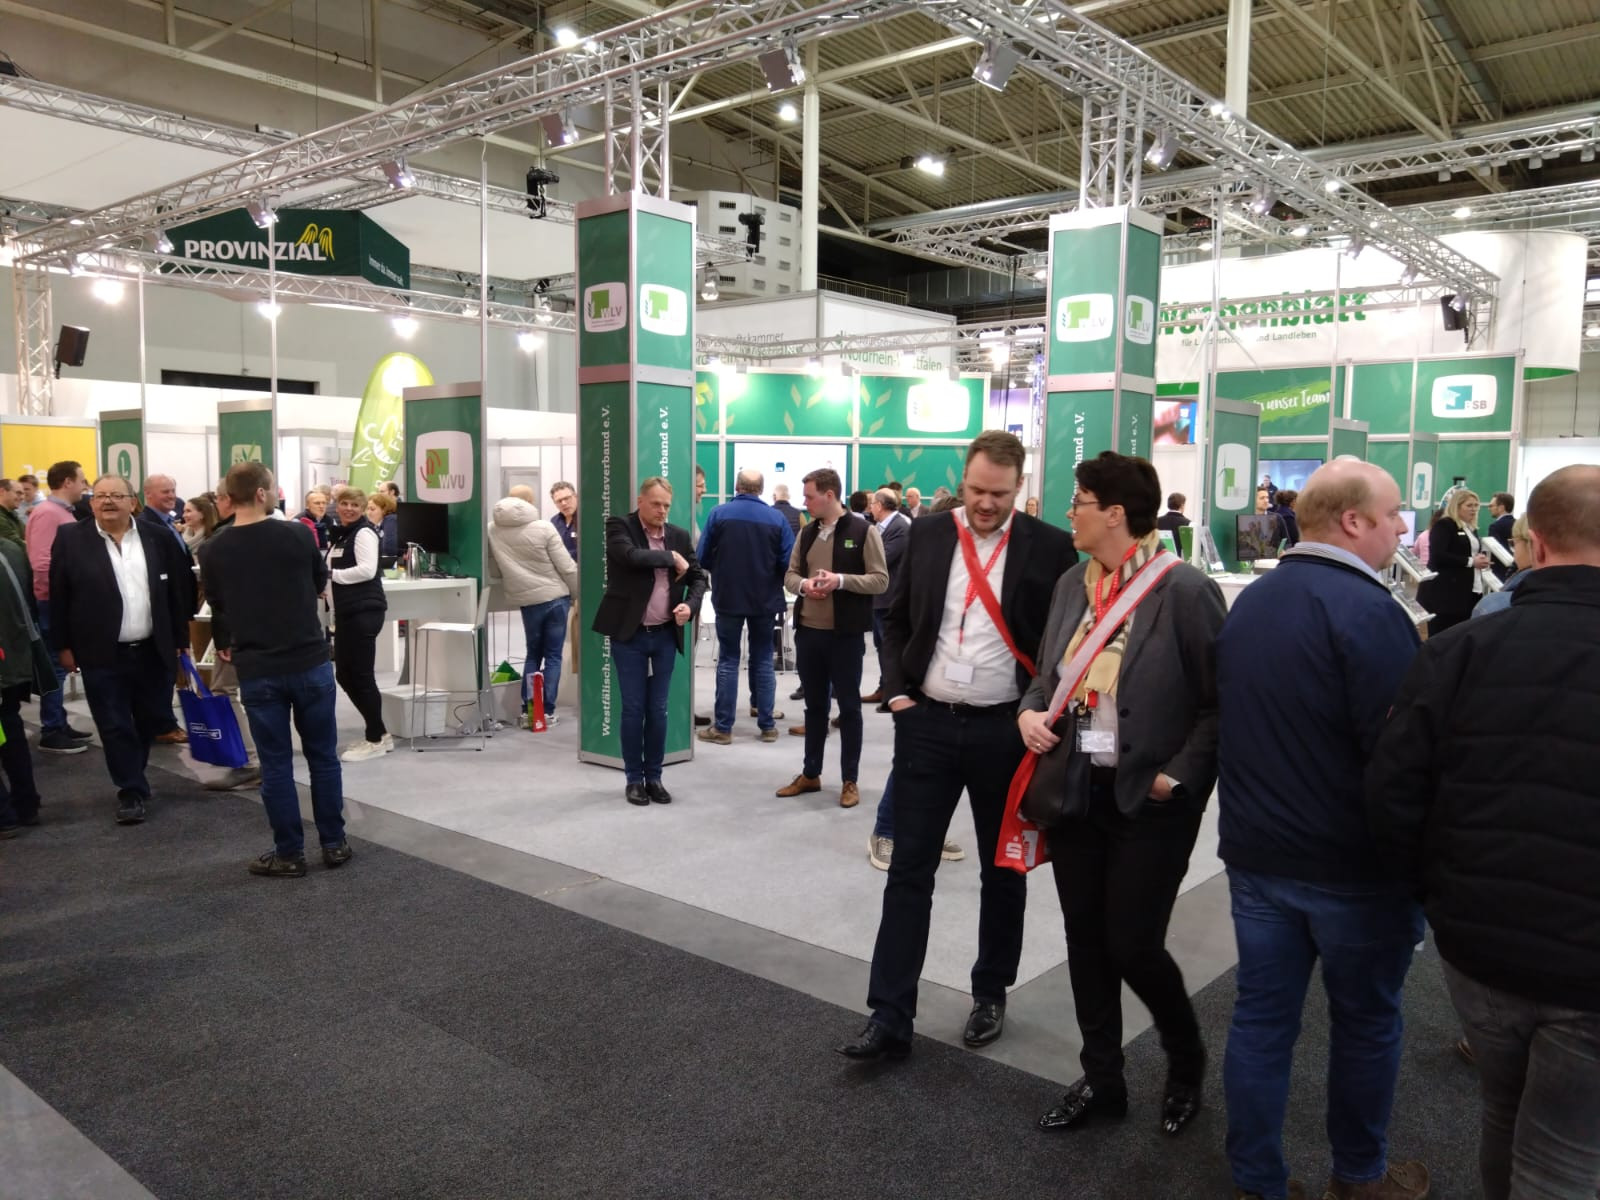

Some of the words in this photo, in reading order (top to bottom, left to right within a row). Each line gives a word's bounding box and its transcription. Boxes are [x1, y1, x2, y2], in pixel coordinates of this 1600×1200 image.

[184, 240, 327, 261] PROVINZIAL
[1272, 332, 1317, 341] Landleben
[659, 432, 669, 479] erband
